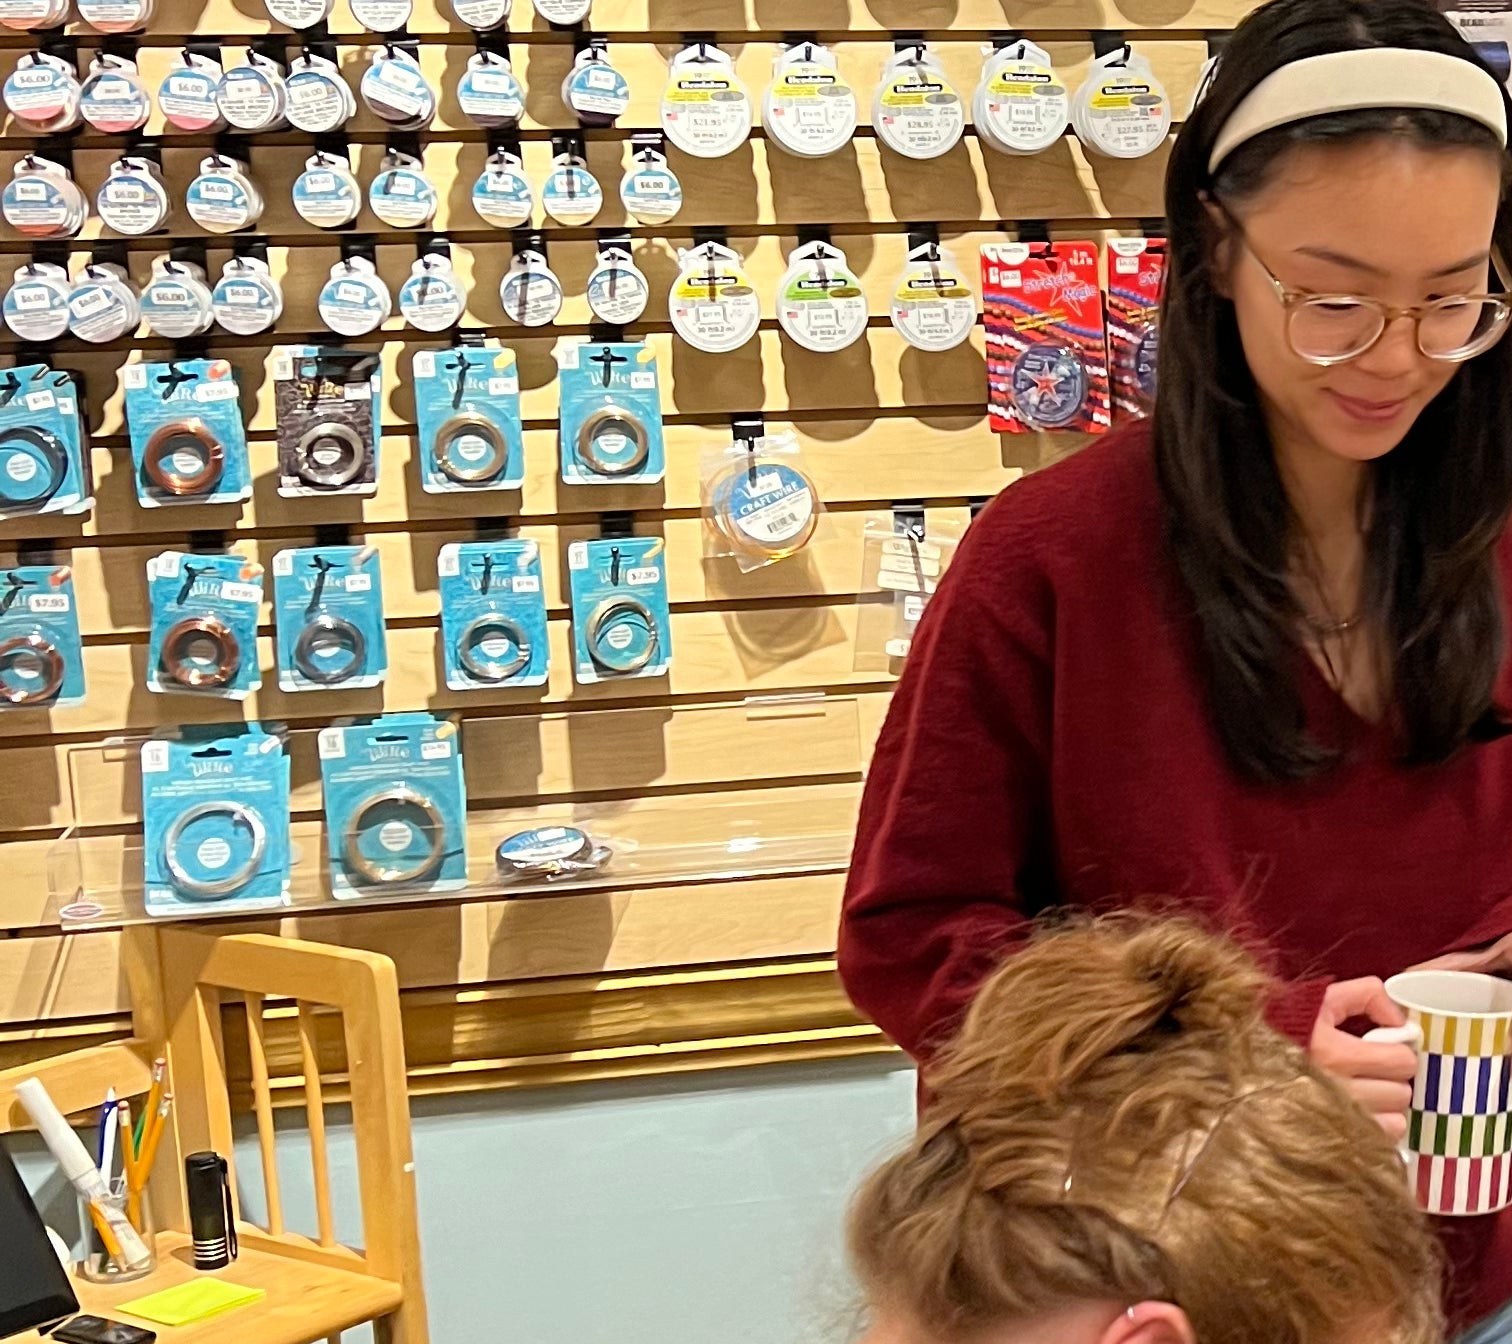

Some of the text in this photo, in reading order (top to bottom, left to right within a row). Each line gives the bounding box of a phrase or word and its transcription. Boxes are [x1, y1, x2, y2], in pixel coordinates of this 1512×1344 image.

[19, 74, 50, 84] $6.00
[178, 83, 203, 93] $6.00
[640, 180, 663, 188] $6.00
[156, 293, 185, 302] $6.00
[738, 481, 799, 516] CRAFT WIRE
[34, 598, 65, 608] $7.95
